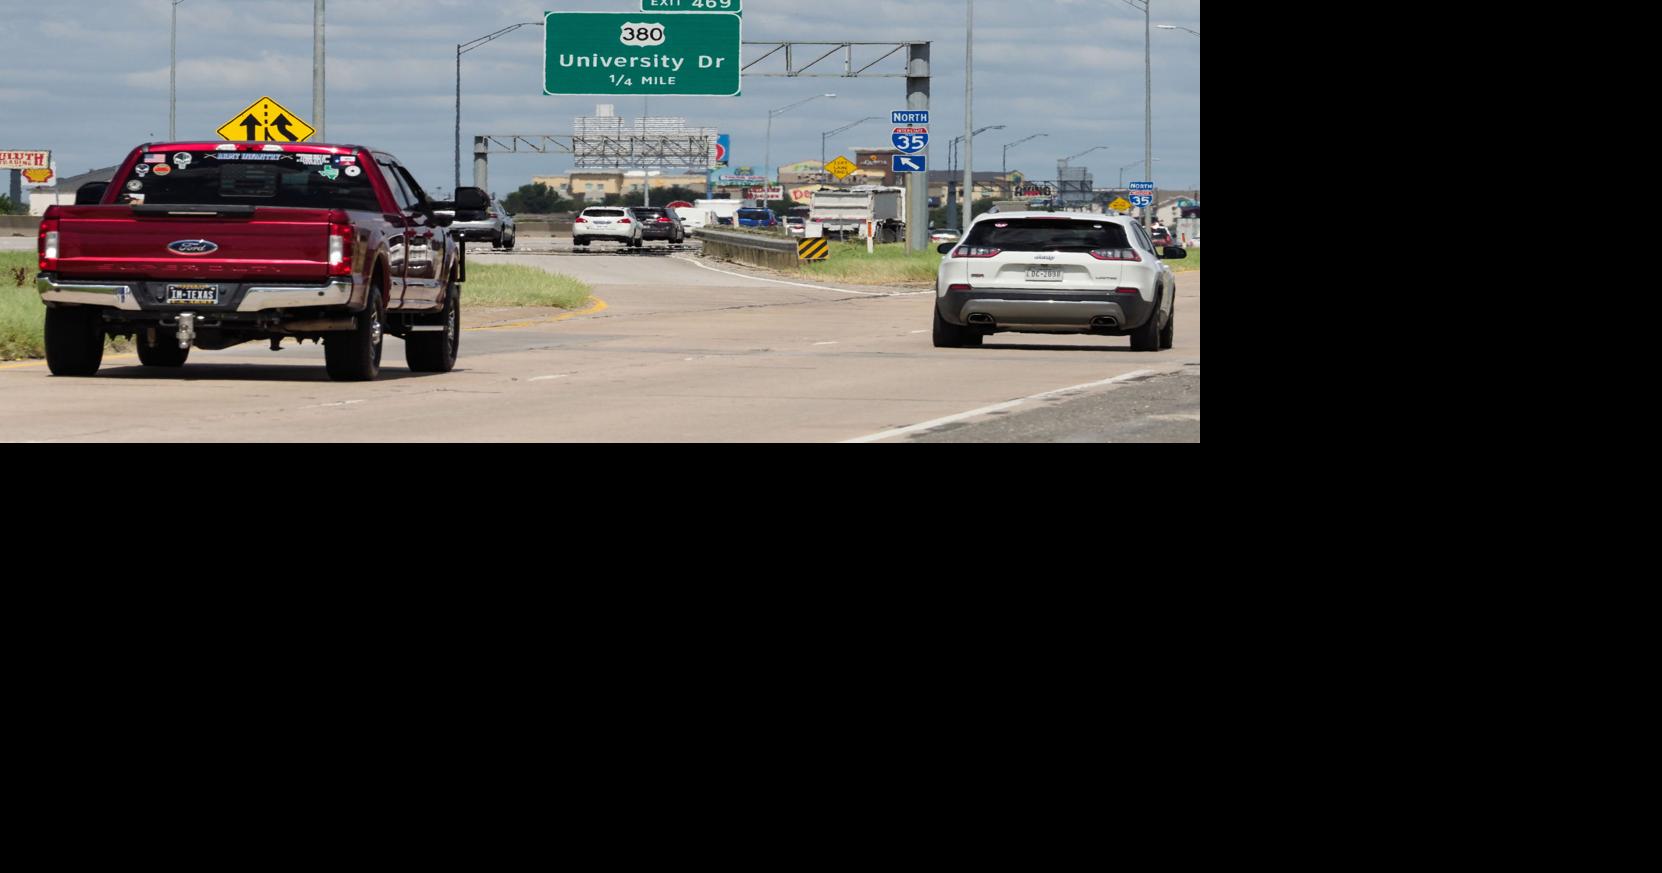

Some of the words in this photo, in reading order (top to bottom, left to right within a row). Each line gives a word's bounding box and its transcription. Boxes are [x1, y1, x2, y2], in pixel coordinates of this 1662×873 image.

[622, 27, 663, 41] 380
[559, 53, 684, 71] University
[698, 55, 726, 68] Dr
[609, 74, 633, 86] 1/4
[641, 76, 676, 85] MILE
[893, 112, 928, 122] NORTH
[897, 135, 924, 149] 35
[1132, 196, 1150, 205] 35
